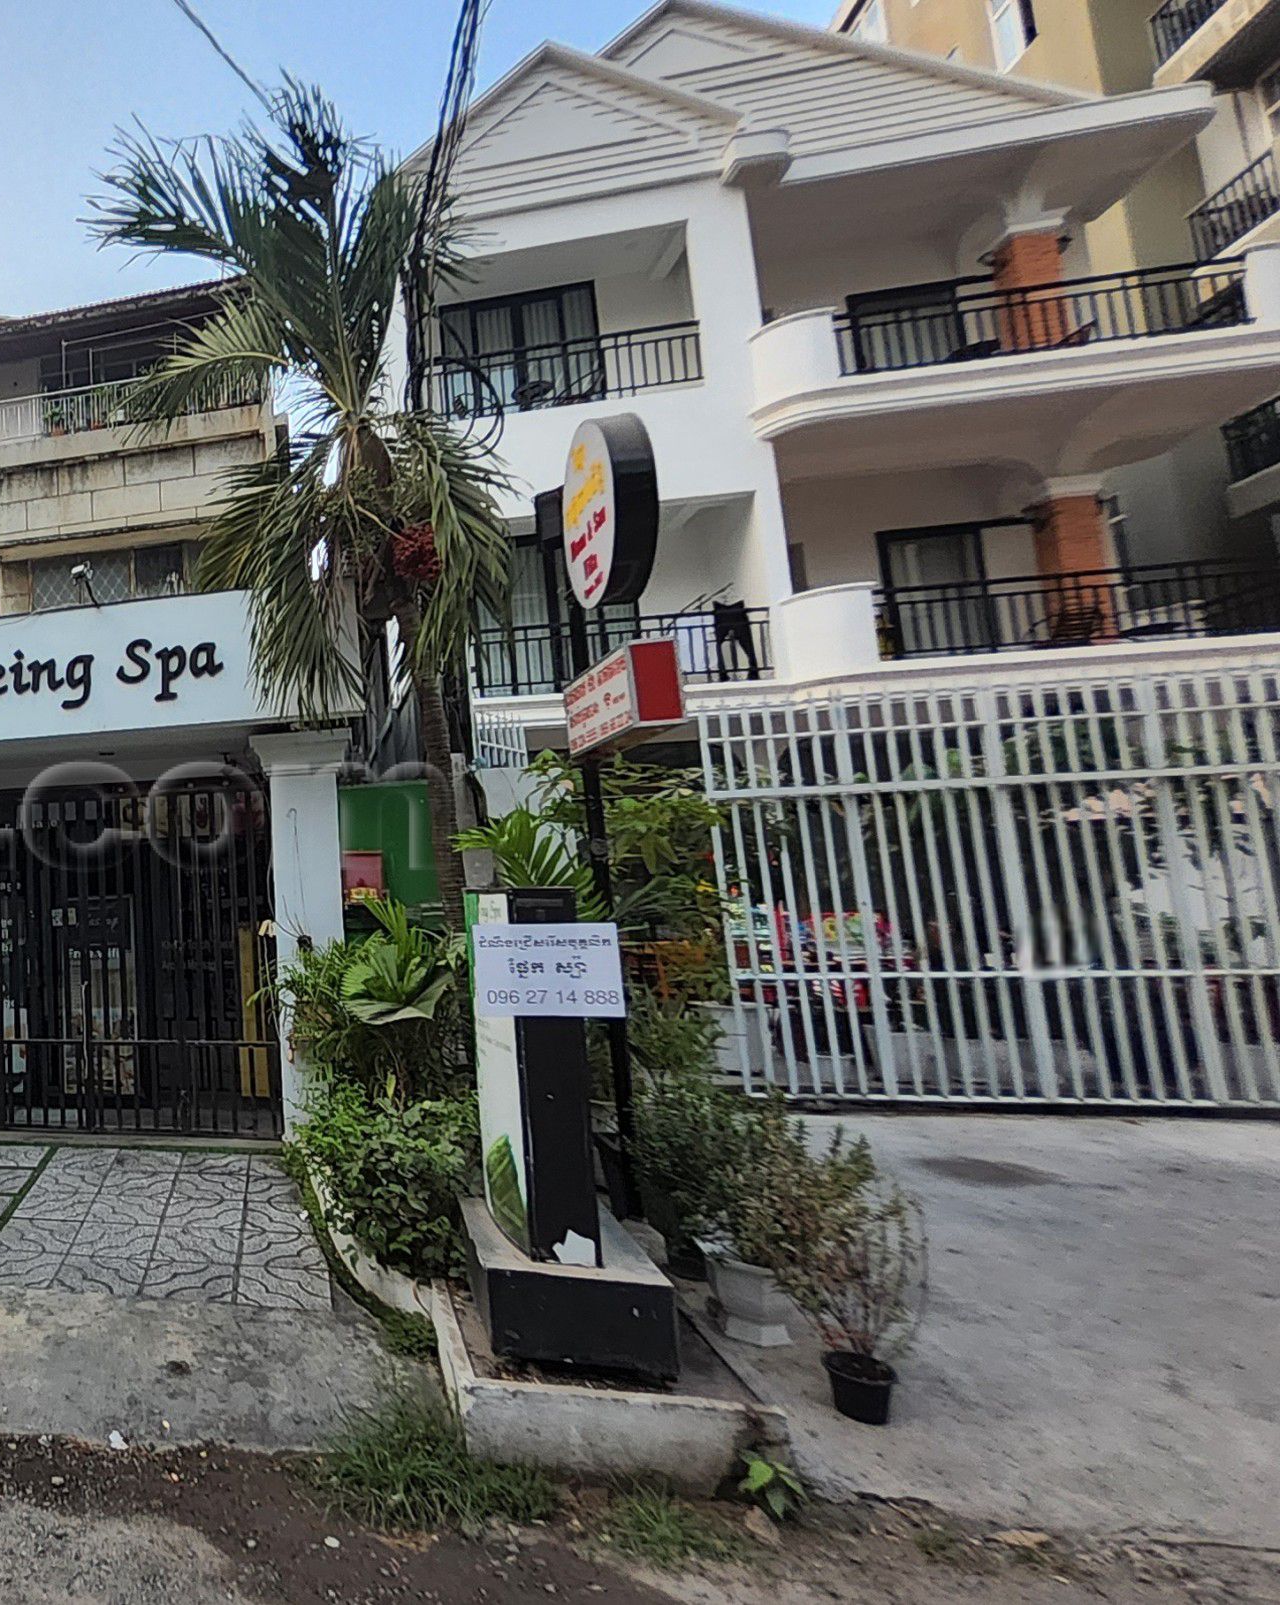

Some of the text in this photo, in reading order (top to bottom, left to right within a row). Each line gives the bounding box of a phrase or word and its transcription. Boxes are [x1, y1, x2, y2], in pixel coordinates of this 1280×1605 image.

[116, 638, 224, 702] Spa
[487, 989, 619, 1006] 096 27 14 888
